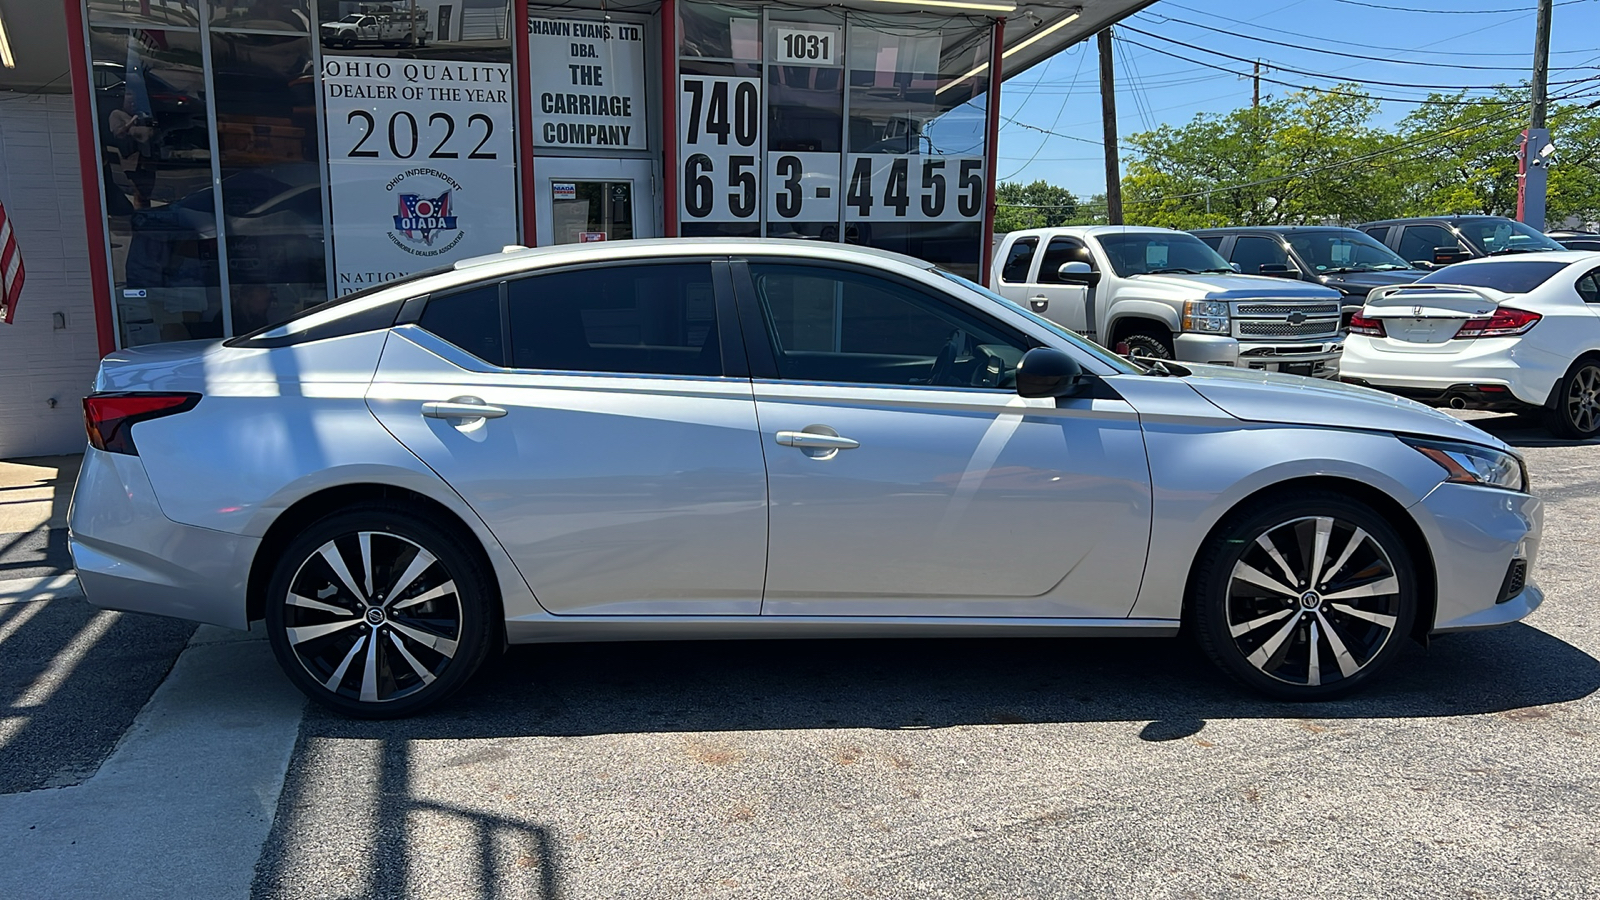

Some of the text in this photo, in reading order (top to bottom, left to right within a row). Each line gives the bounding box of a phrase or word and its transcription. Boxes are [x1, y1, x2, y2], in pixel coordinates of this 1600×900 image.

[618, 26, 642, 41] LTD.
[570, 43, 599, 58] DBA.
[783, 34, 829, 60] 1031
[326, 60, 509, 83] OHIO QUALITY
[568, 64, 603, 86] THE
[329, 84, 508, 103] DEALER OF THE YEAR
[541, 92, 632, 117] CARRIAGE
[683, 80, 758, 147] 740
[347, 109, 498, 160] 2022
[542, 122, 632, 146] COMPANY
[386, 168, 463, 191] OHIO INDEPENDENT
[402, 217, 447, 229] OIADA
[387, 230, 465, 257] AUTOMOBILE DEALERS ASSOCIATION
